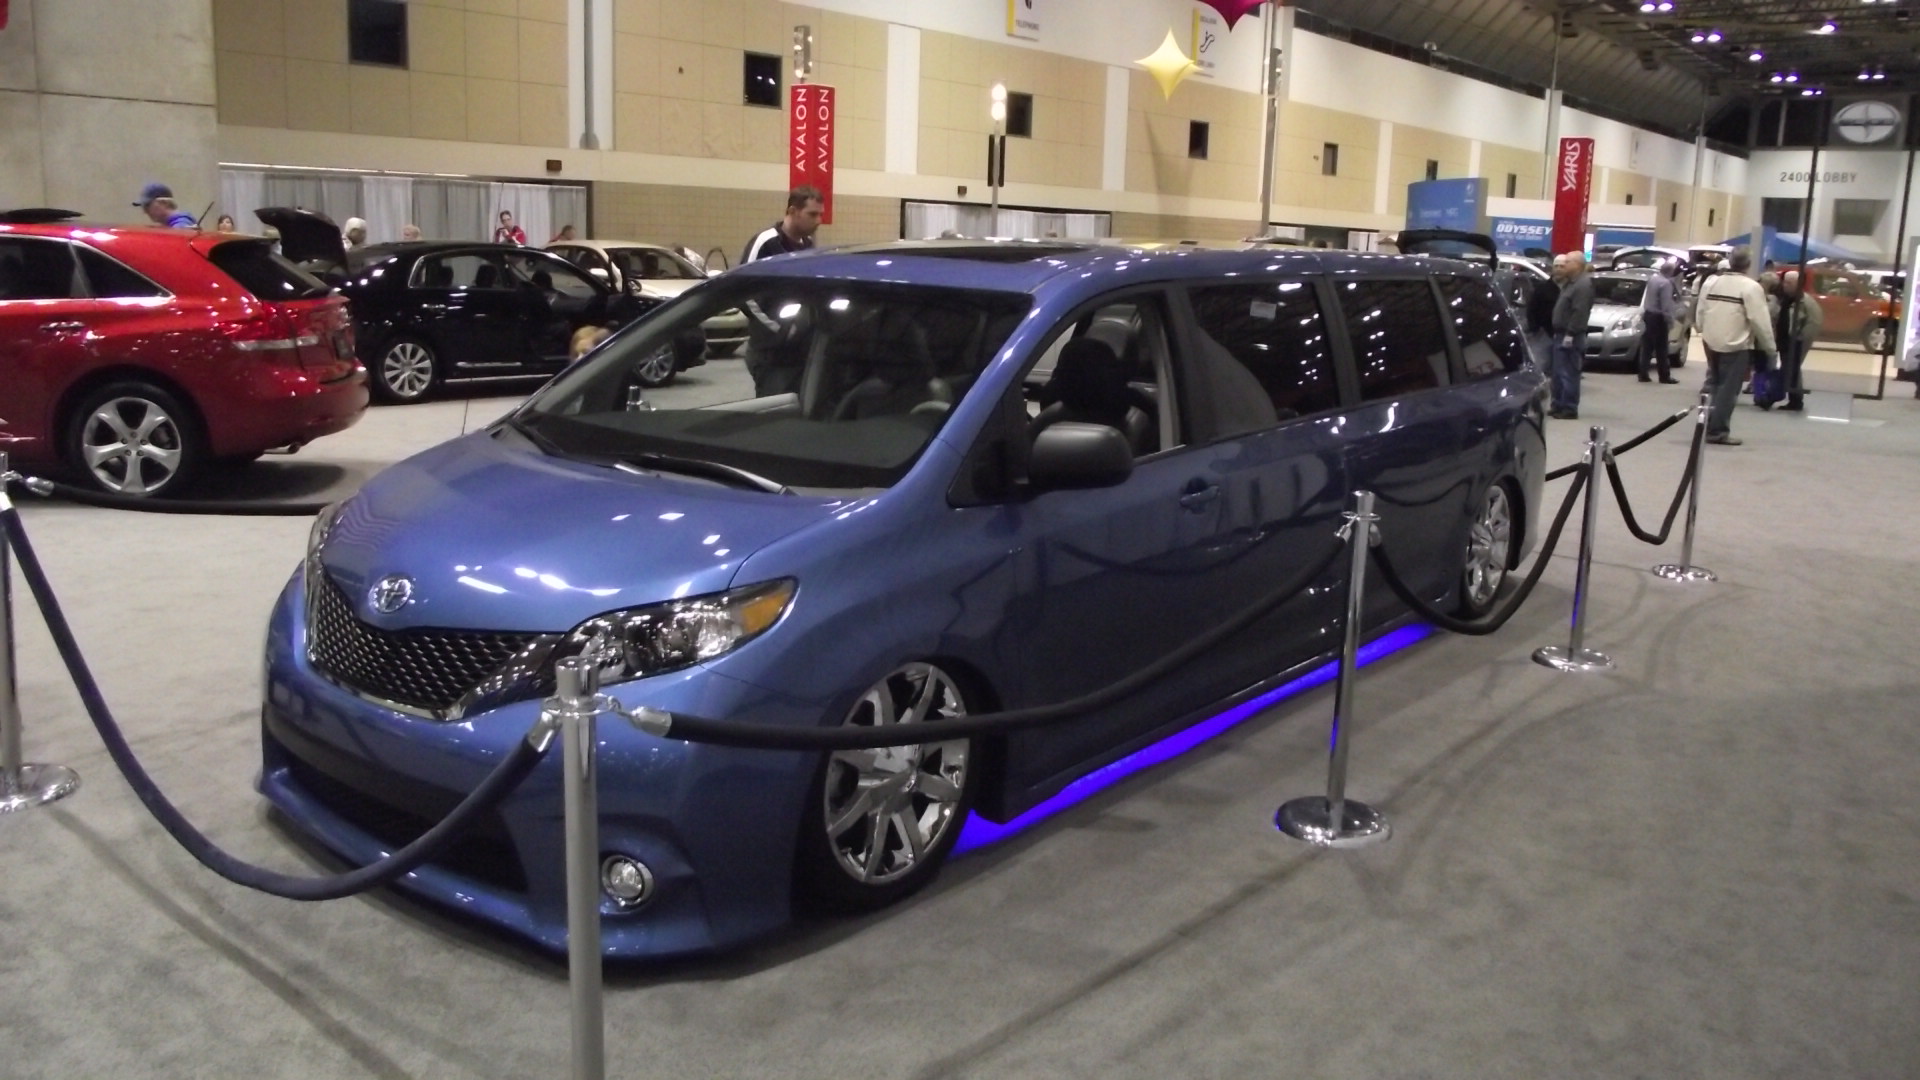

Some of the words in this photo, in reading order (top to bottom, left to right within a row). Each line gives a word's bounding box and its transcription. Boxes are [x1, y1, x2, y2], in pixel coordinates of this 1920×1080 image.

[795, 88, 807, 172] AVALON
[818, 89, 829, 173] AVALON
[1561, 141, 1580, 191] YARIS
[1780, 171, 1811, 183] 2400
[1814, 171, 1858, 183] LOBBY
[1496, 223, 1553, 235] ODYSSEY
